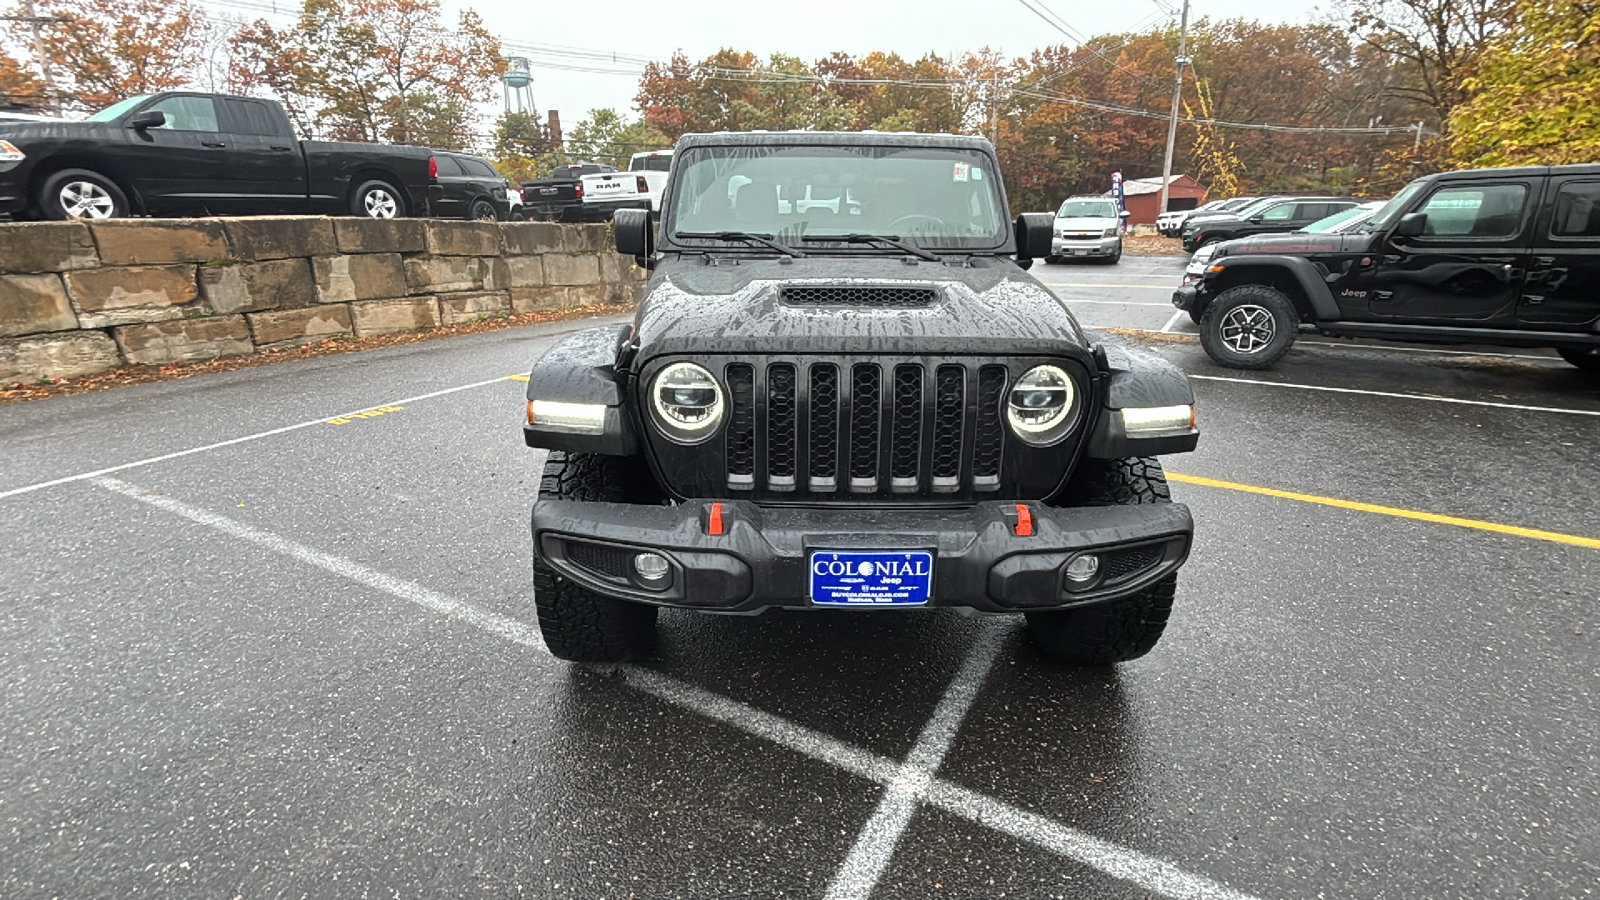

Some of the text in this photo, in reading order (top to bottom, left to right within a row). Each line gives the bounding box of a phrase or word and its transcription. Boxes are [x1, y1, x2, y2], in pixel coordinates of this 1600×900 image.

[1341, 288, 1367, 298] Jeep
[813, 561, 929, 576] COLONIAL
[880, 577, 902, 585] Jeep
